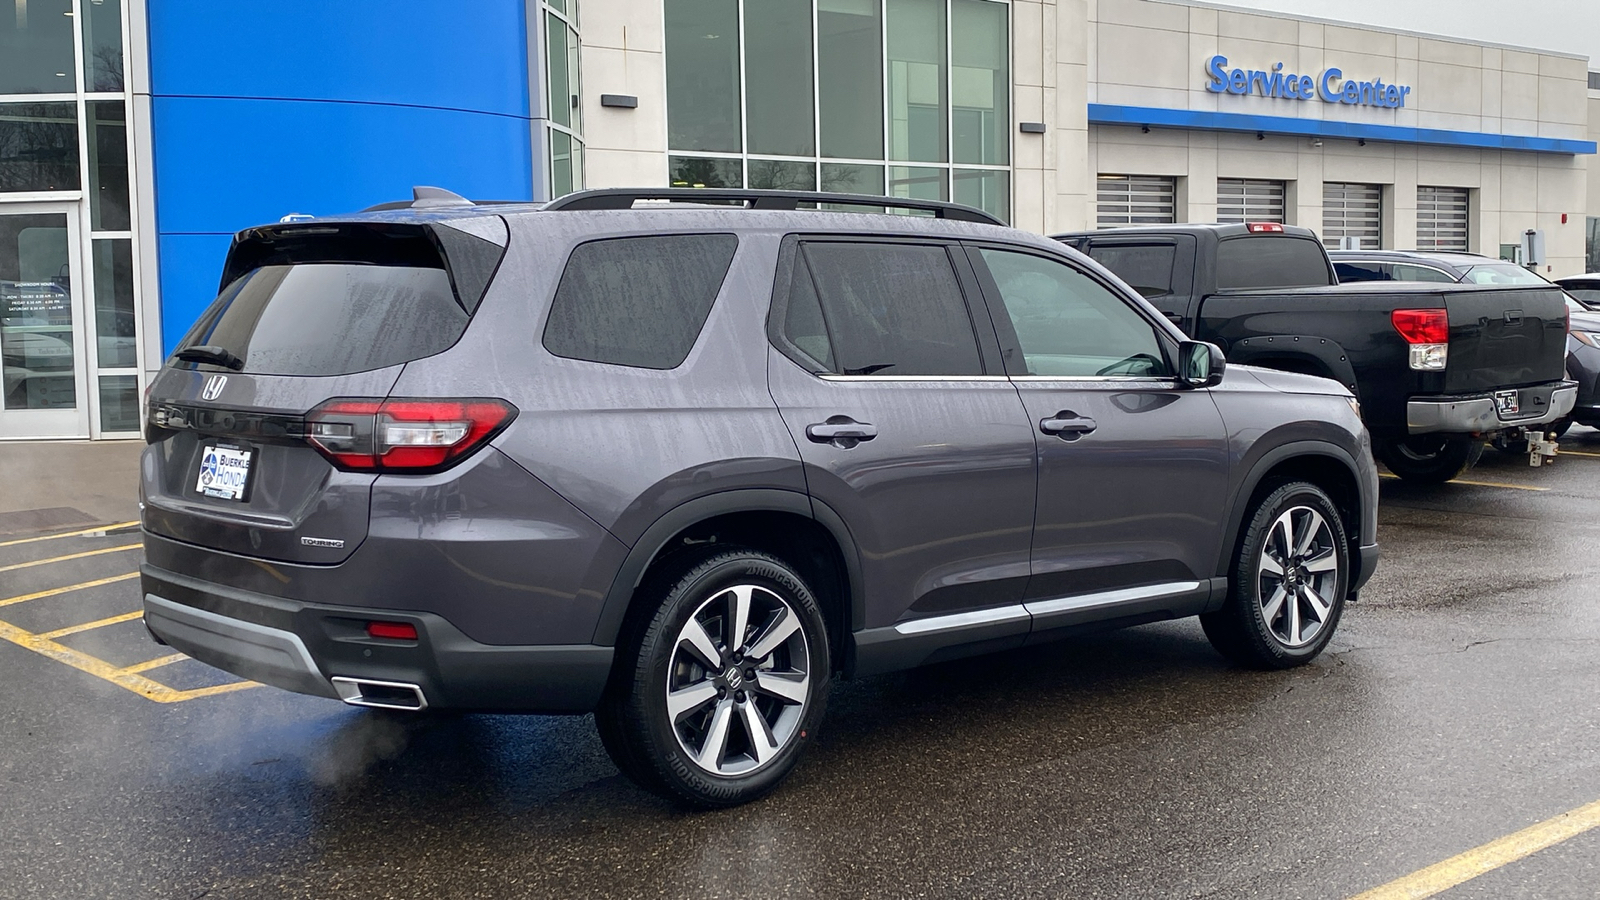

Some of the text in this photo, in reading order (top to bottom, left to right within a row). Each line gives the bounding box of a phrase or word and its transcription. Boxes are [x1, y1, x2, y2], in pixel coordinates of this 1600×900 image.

[1206, 55, 1411, 108] Service Center
[215, 466, 247, 488] HONDA
[220, 454, 250, 469] BUERKLE
[302, 538, 343, 548] TOURING
[745, 564, 817, 615] BRIDGESTONE
[664, 750, 743, 799] BRIDGESTONE
